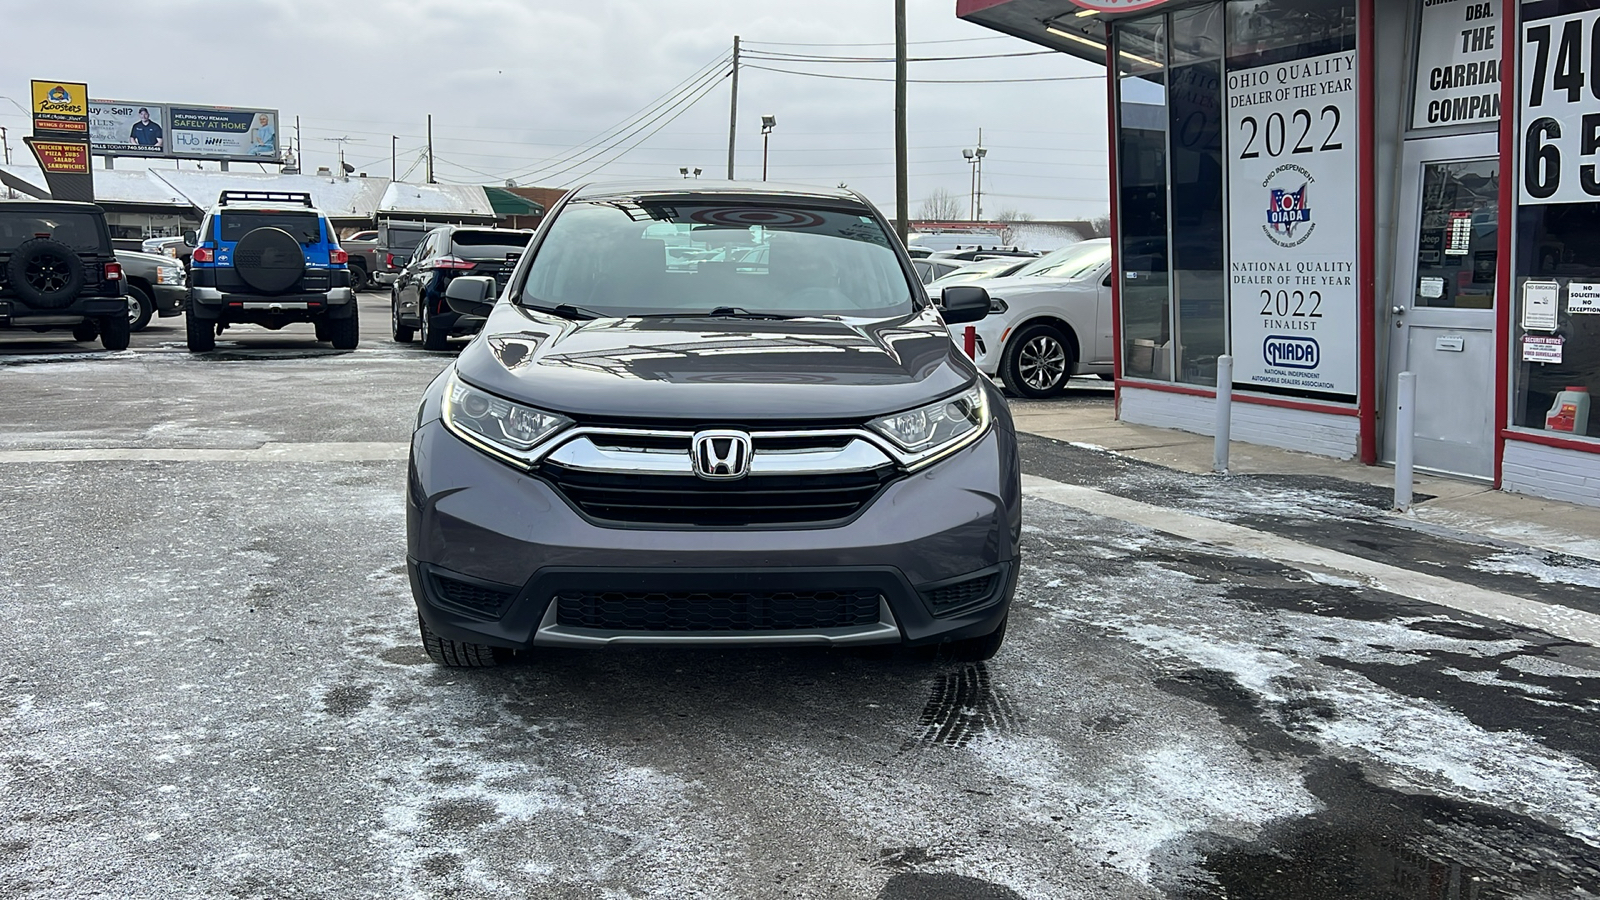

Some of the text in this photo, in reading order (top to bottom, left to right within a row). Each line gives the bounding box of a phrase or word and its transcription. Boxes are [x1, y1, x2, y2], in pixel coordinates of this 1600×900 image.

[1465, 2, 1494, 22] DBA.
[1461, 25, 1496, 54] THE
[1229, 55, 1354, 90] OHIO QUALITY
[1429, 59, 1502, 91] CARRIA
[1230, 77, 1353, 108] DEALER OF THE YEAR
[39, 99, 82, 113] Roosters
[111, 107, 133, 116] Sell?
[174, 119, 247, 130] SAFELY AT HOME
[1239, 104, 1343, 160] 2022
[47, 162, 85, 170] SANDWICHES
[1262, 163, 1316, 188] OHIO INDEPENDENT
[1271, 210, 1303, 222] OIADA
[1421, 234, 1440, 245] Jeep
[1232, 262, 1353, 274] NATIONAL QUALITY
[1233, 275, 1351, 286] DEALER OF THE YEAR
[1259, 289, 1323, 318] 2022
[1264, 320, 1317, 331] FINALIST
[1268, 342, 1315, 362] NIADA
[1251, 375, 1335, 389] AUTOMOBILE DEALERS ASSOCIATION
[1287, 371, 1320, 379] INDEPENDENT
